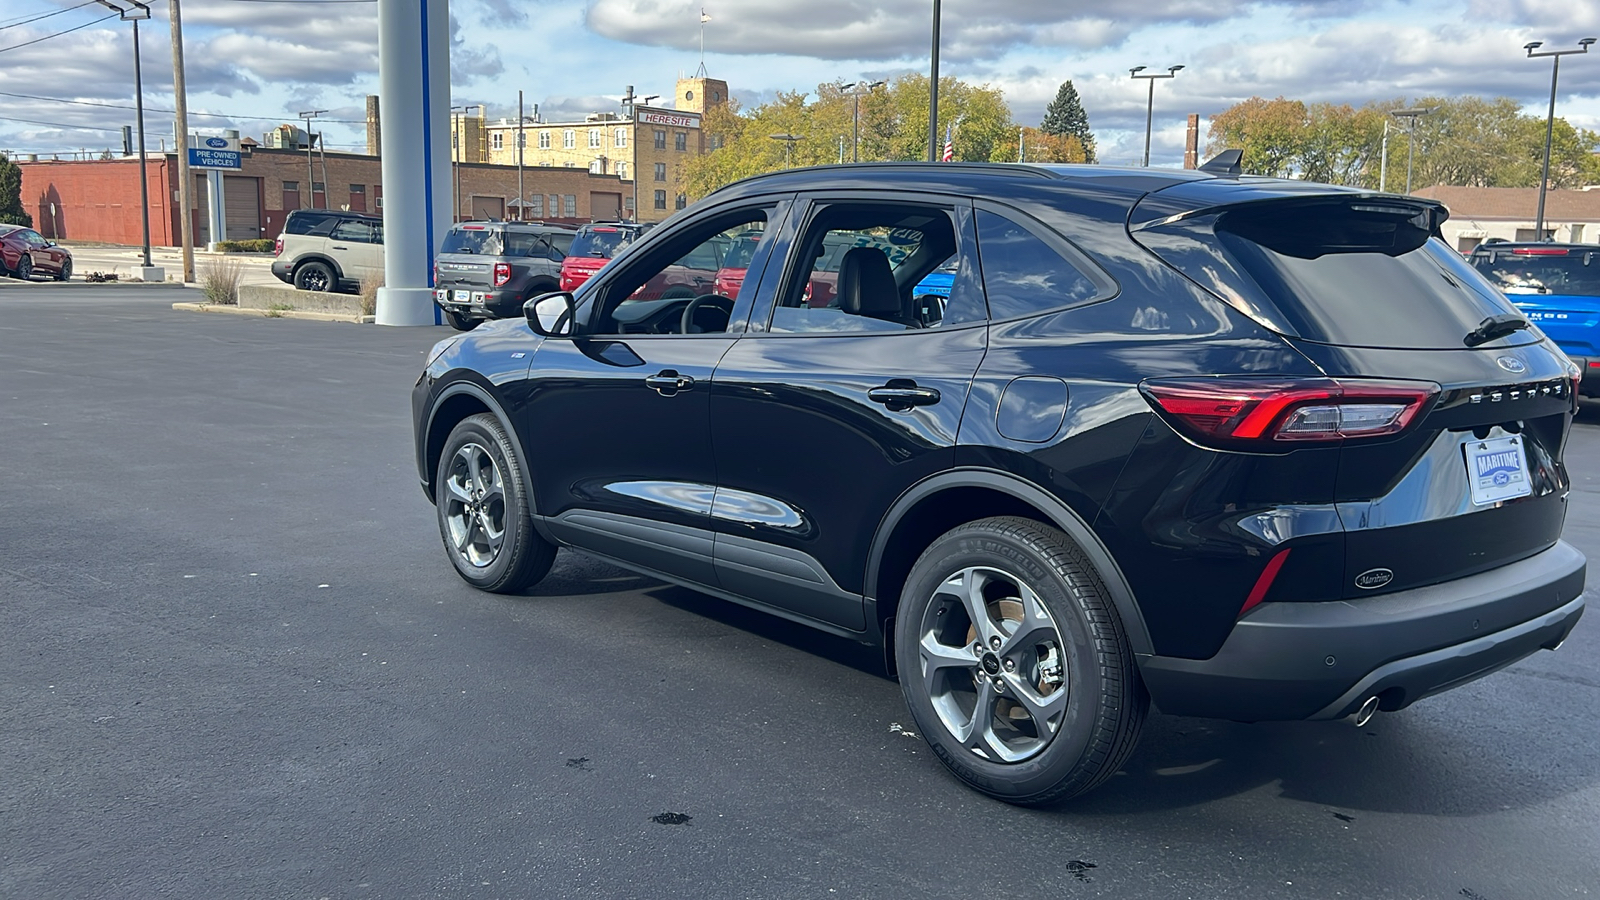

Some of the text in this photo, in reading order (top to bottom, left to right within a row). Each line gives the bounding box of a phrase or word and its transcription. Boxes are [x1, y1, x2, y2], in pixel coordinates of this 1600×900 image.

[646, 114, 691, 126] HERESITE
[196, 151, 237, 160] PRE-OWNED
[1469, 384, 1562, 404] ESCAPE
[1478, 452, 1519, 475] MARITIME
[1495, 474, 1508, 485] Ford
[986, 542, 1043, 578] MICHELIN
